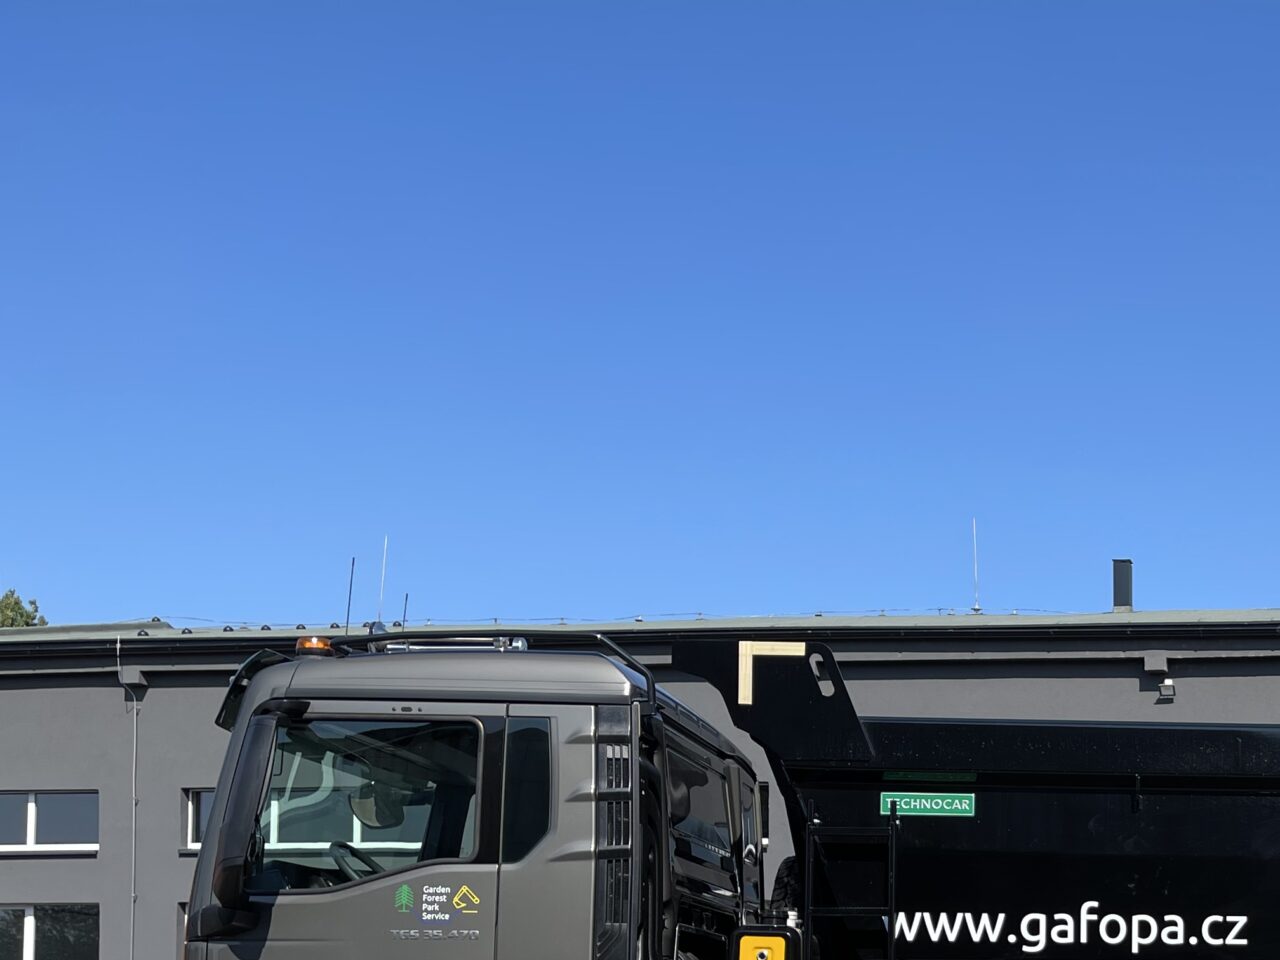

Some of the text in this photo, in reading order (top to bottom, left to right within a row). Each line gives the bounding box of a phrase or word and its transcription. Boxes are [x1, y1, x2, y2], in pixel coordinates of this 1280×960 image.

[885, 797, 970, 811] TECHNOCAR
[423, 885, 451, 893] Garden
[422, 894, 447, 902] Forest
[422, 903, 440, 911] Park
[422, 912, 450, 921] Service
[881, 900, 1249, 954] www.gafopa.cz
